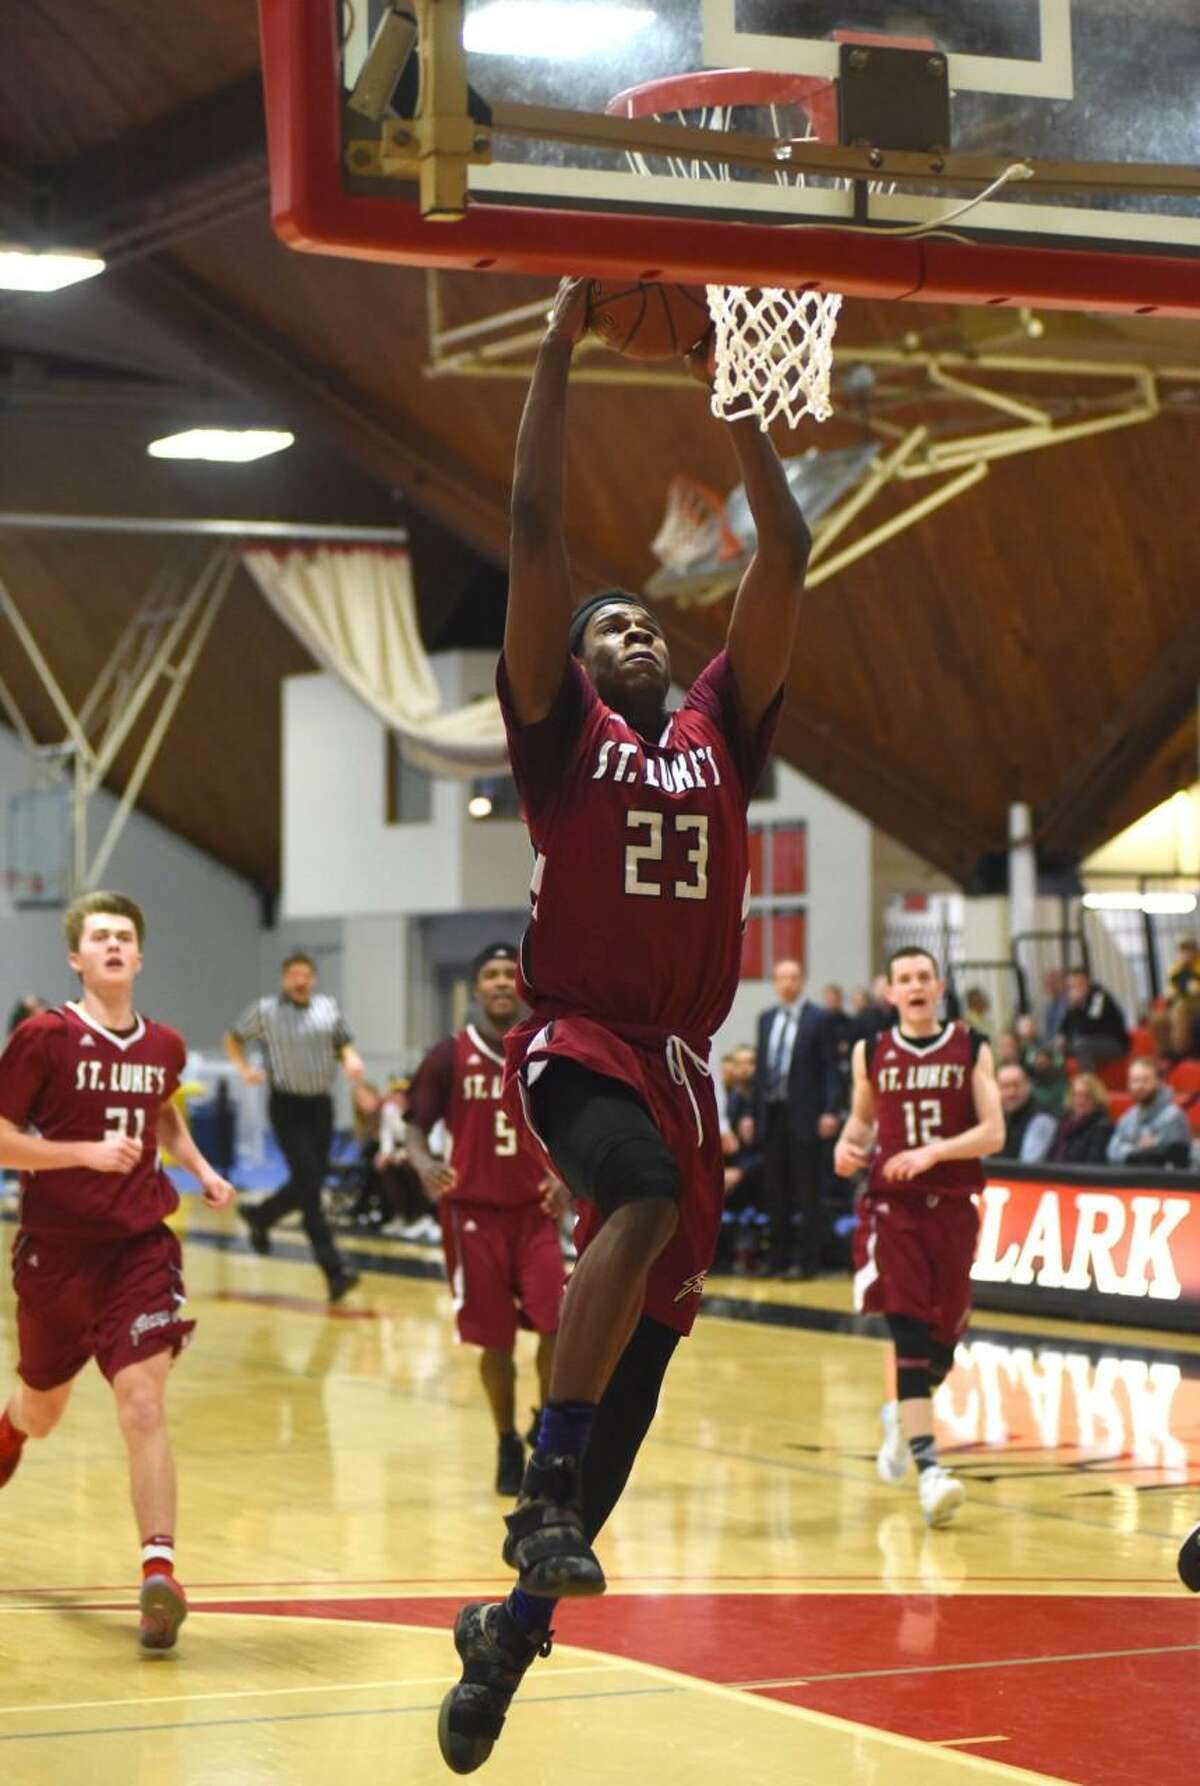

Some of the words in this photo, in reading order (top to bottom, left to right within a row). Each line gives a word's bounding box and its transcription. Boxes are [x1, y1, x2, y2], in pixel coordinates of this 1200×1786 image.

[592, 740, 638, 783] ST.
[645, 746, 720, 793] LUKE'S
[625, 810, 708, 899] 23
[76, 1061, 105, 1091] ST.
[110, 1063, 165, 1095] LUKE'S
[464, 1075, 488, 1099] ST.
[879, 1067, 902, 1093] ST.
[906, 1064, 965, 1090] LUKE'S
[495, 1110, 517, 1156] 5
[903, 1100, 941, 1146] 12
[969, 1187, 1190, 1300] LARK
